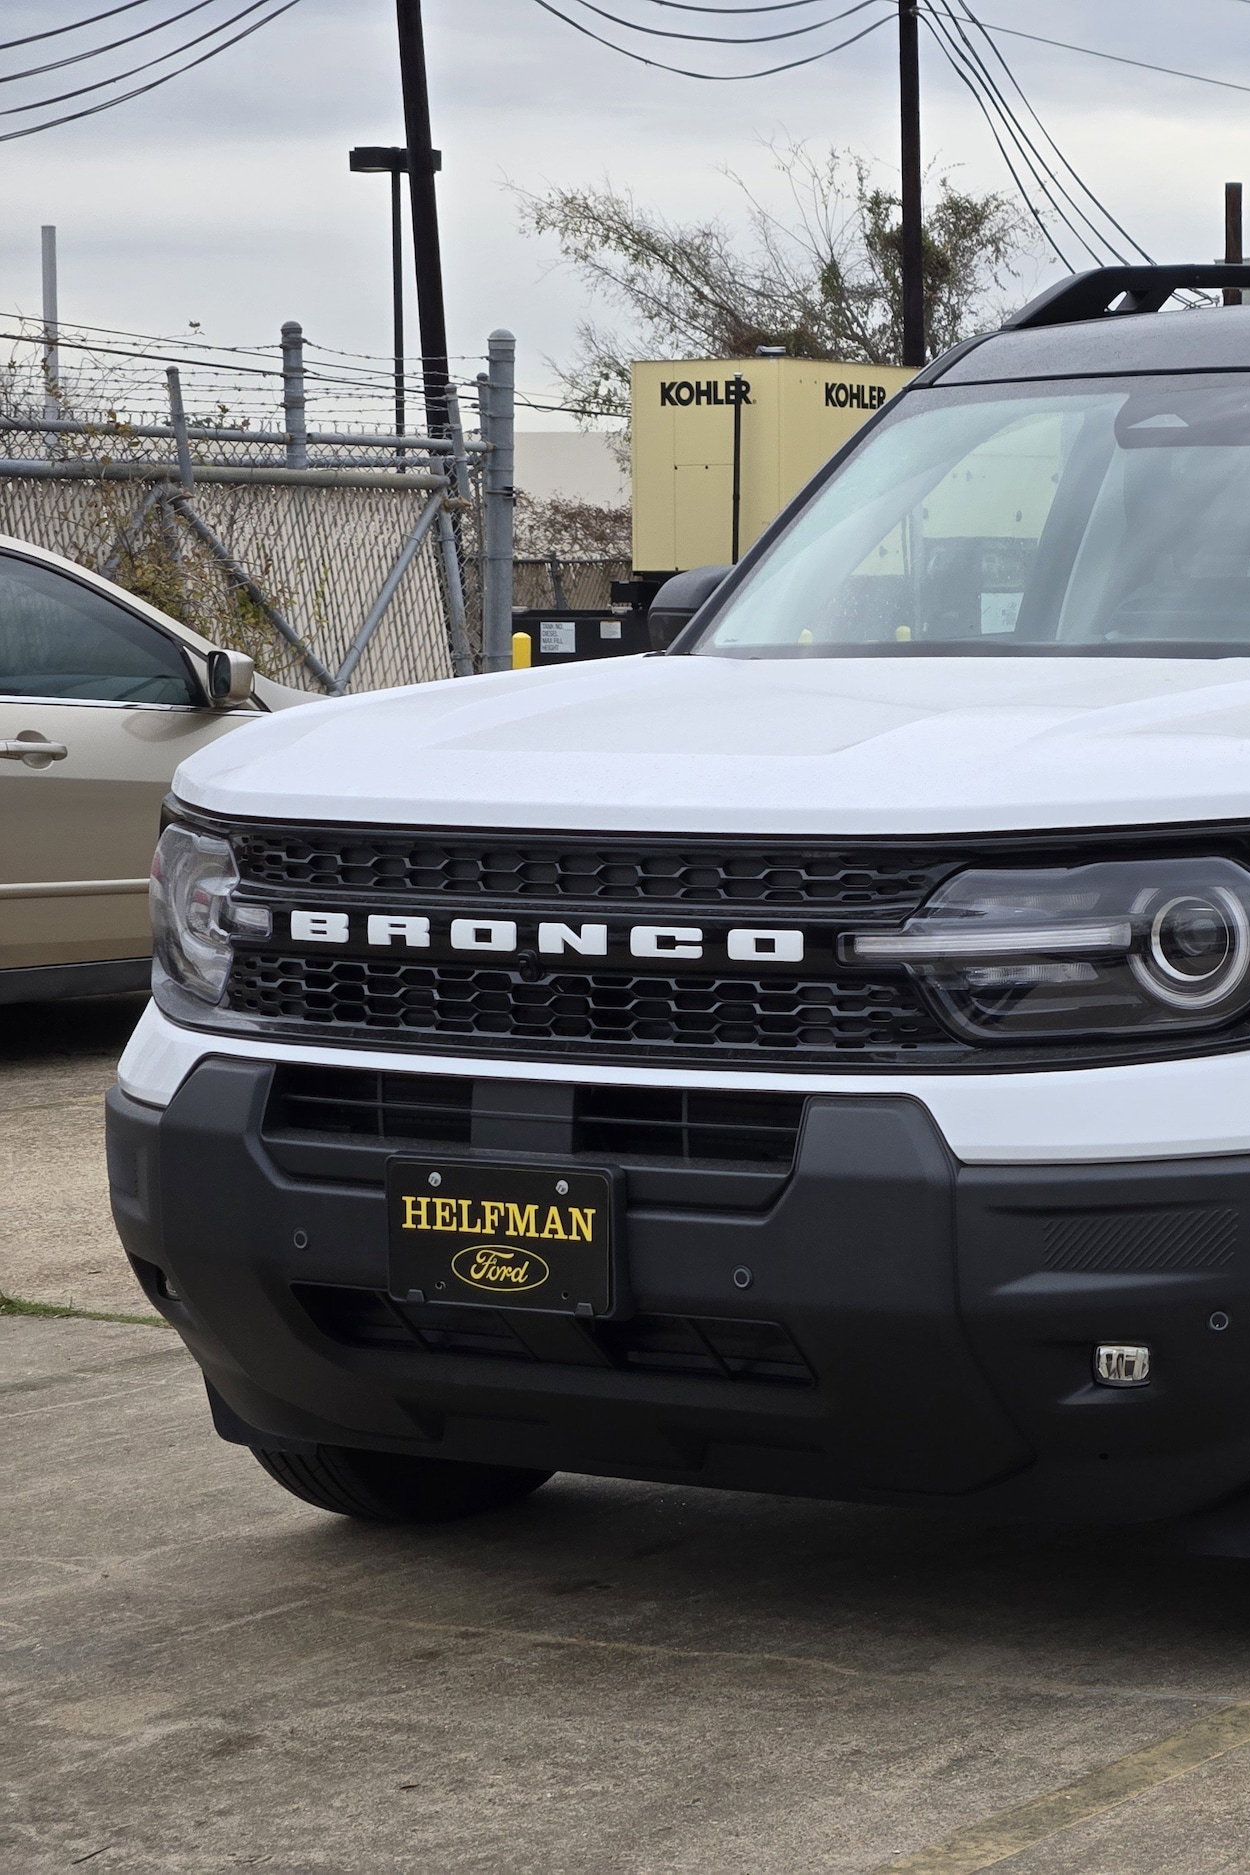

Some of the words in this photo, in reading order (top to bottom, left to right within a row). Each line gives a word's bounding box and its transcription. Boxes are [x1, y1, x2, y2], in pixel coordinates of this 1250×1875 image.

[660, 381, 752, 406] KOHLER
[290, 910, 804, 963] BRONCO
[401, 1195, 597, 1242] HELFMAN
[470, 1249, 530, 1284] Ford
